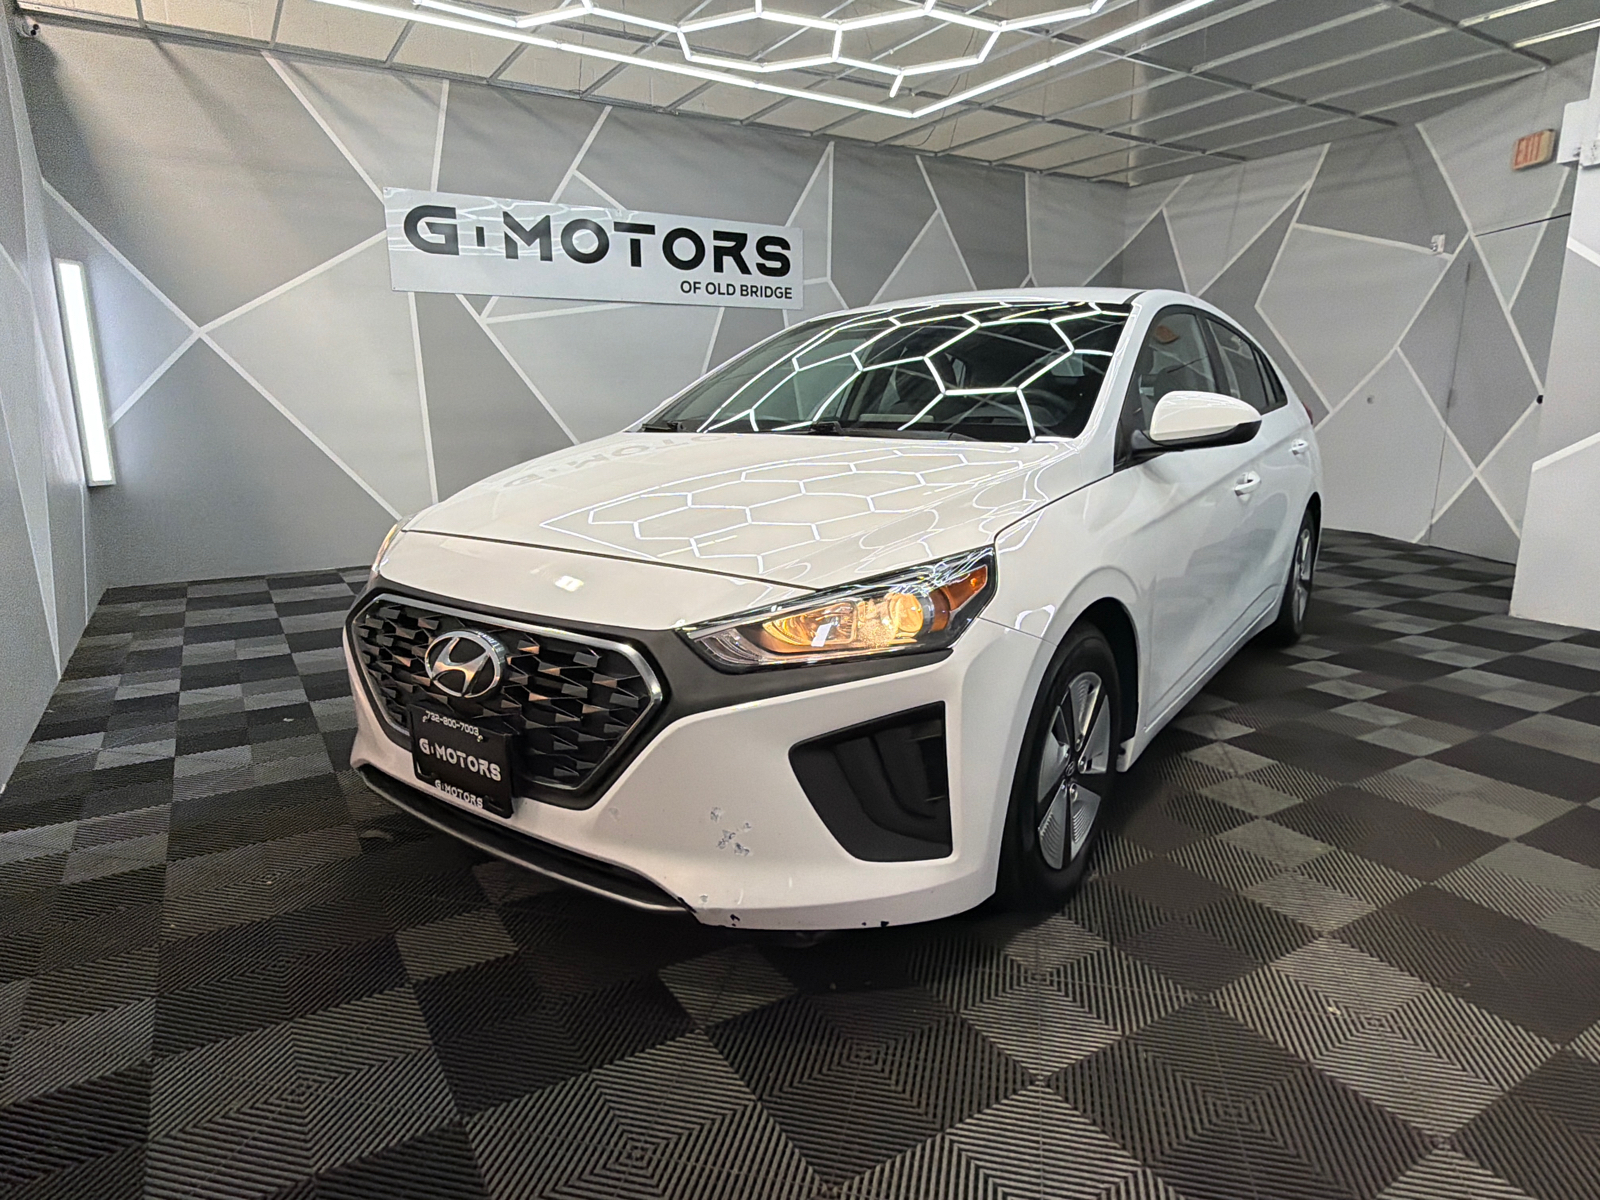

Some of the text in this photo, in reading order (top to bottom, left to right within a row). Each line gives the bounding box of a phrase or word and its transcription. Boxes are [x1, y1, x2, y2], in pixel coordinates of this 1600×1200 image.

[680, 280, 793, 299] OF OLD BRIDGE
